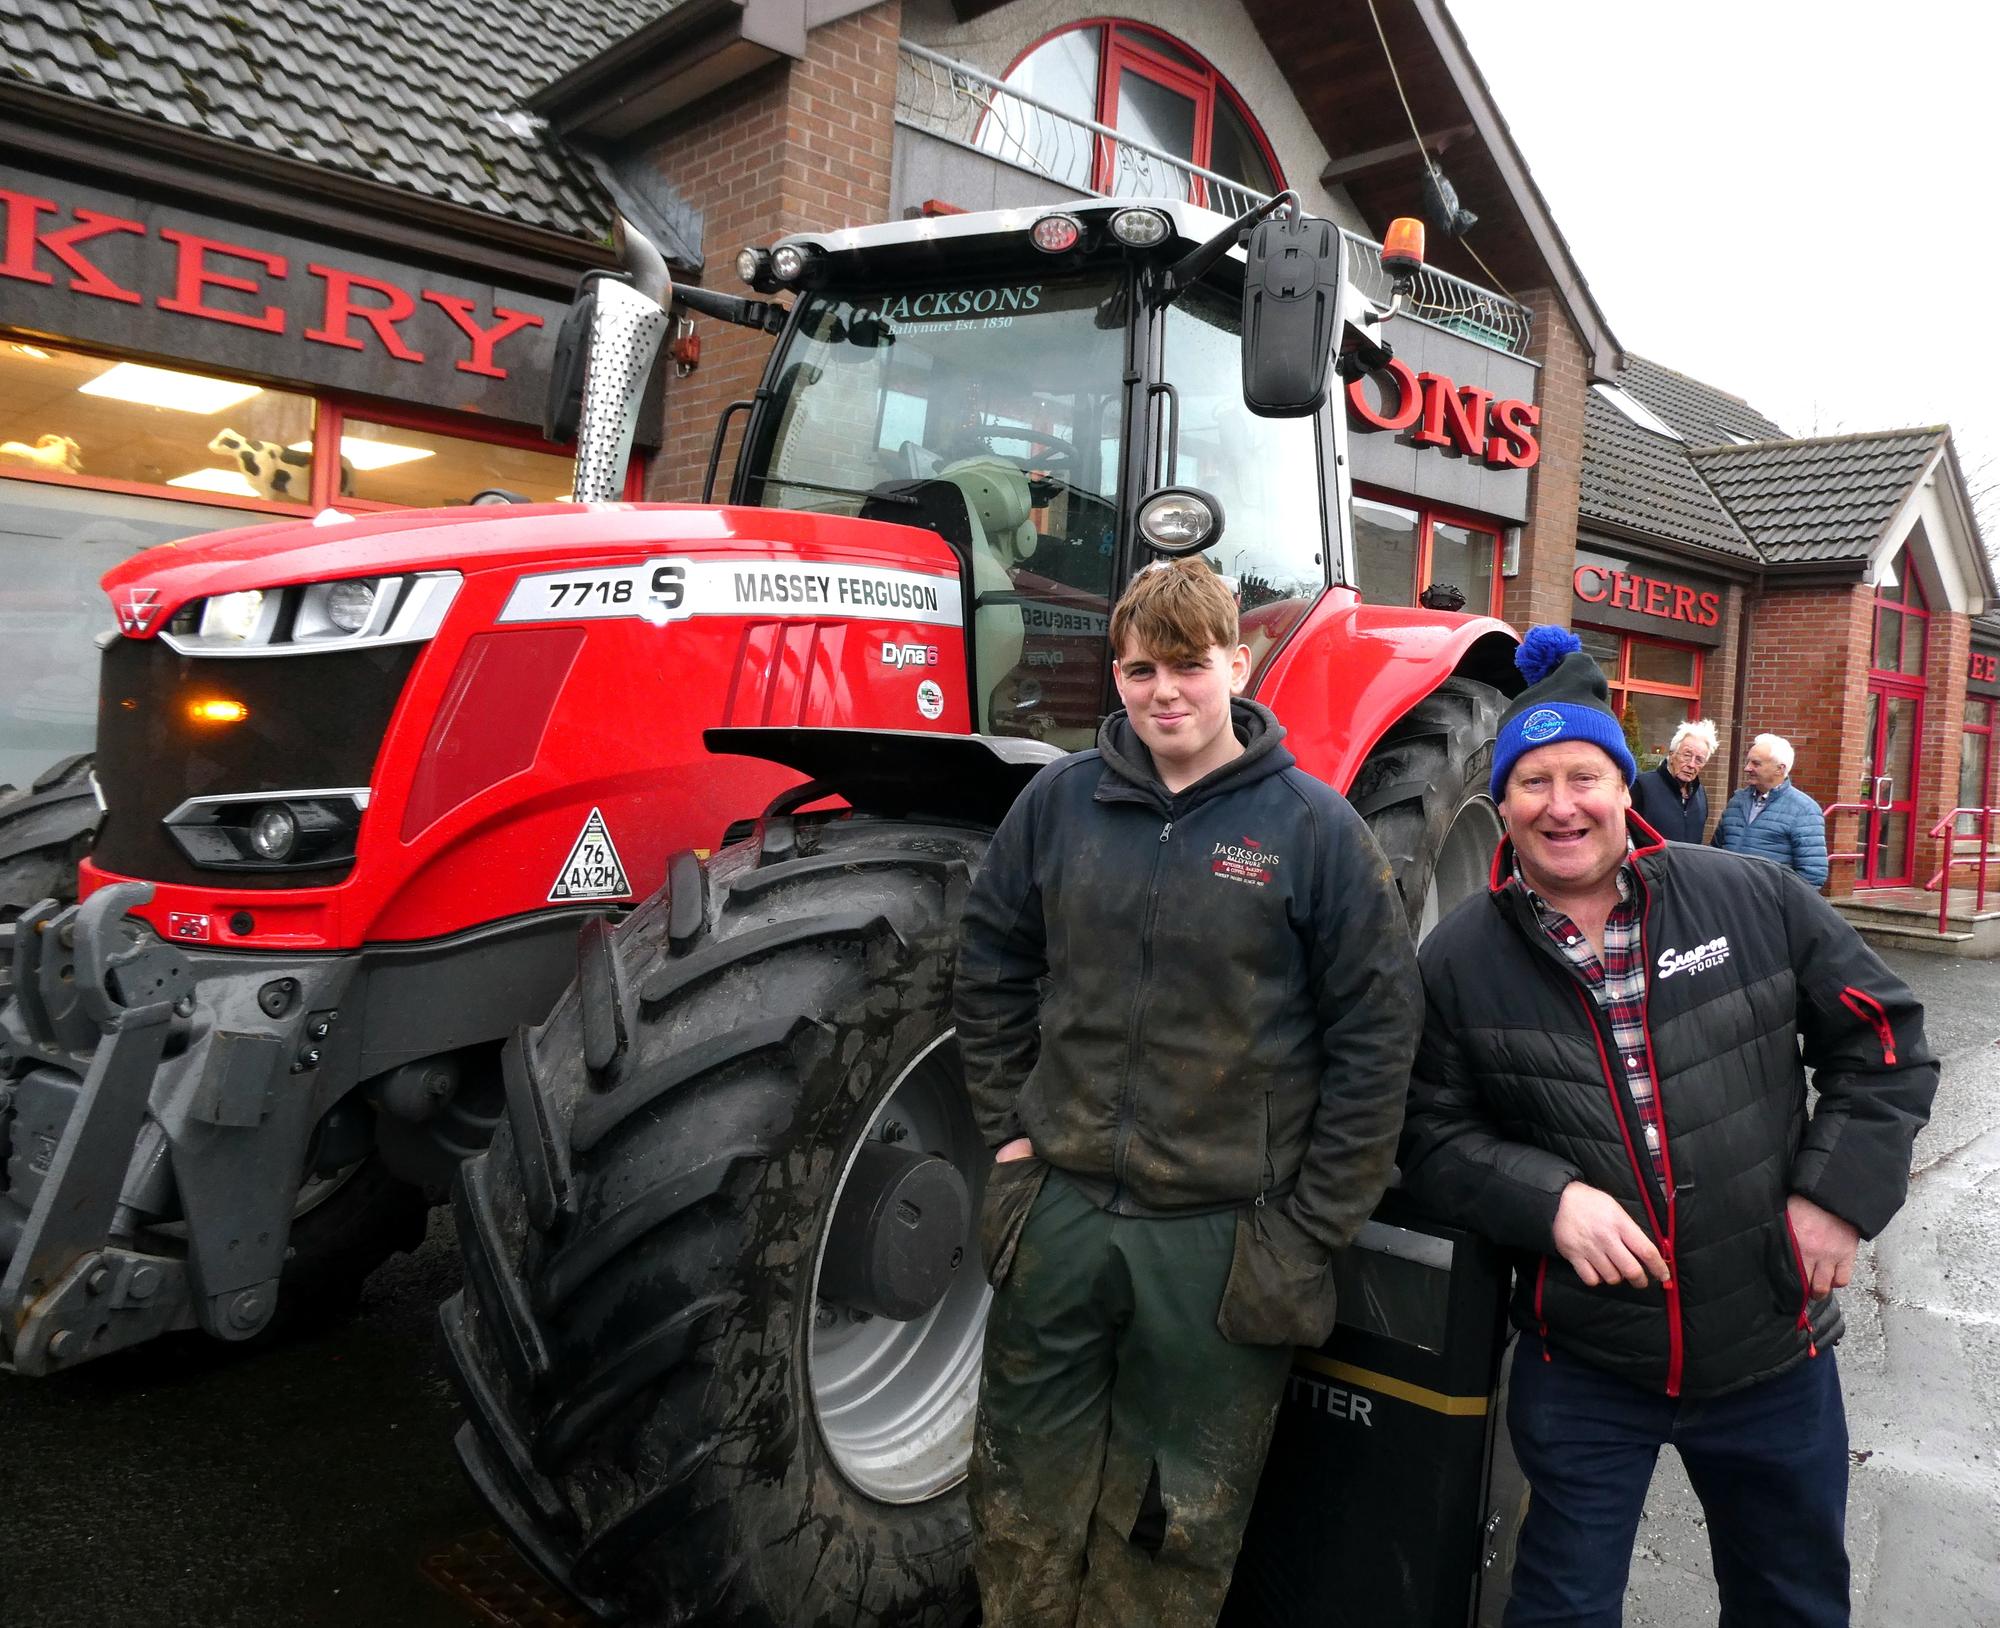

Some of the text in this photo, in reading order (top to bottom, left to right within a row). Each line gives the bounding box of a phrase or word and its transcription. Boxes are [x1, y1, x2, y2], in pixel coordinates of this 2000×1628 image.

[0, 189, 544, 379] KERY
[877, 286, 1043, 320] JACKSONS
[888, 317, 1013, 338] Ballynure Est. 1850
[1347, 357, 1540, 468] ONS
[549, 566, 686, 609] 7718 S
[734, 573, 938, 611] MASSEY FERGUSON
[1573, 565, 1720, 627] CHERS
[1968, 652, 1997, 682] EE
[584, 844, 604, 864] 76
[1212, 843, 1279, 864] JACKSONS
[570, 866, 615, 888] AX2H
